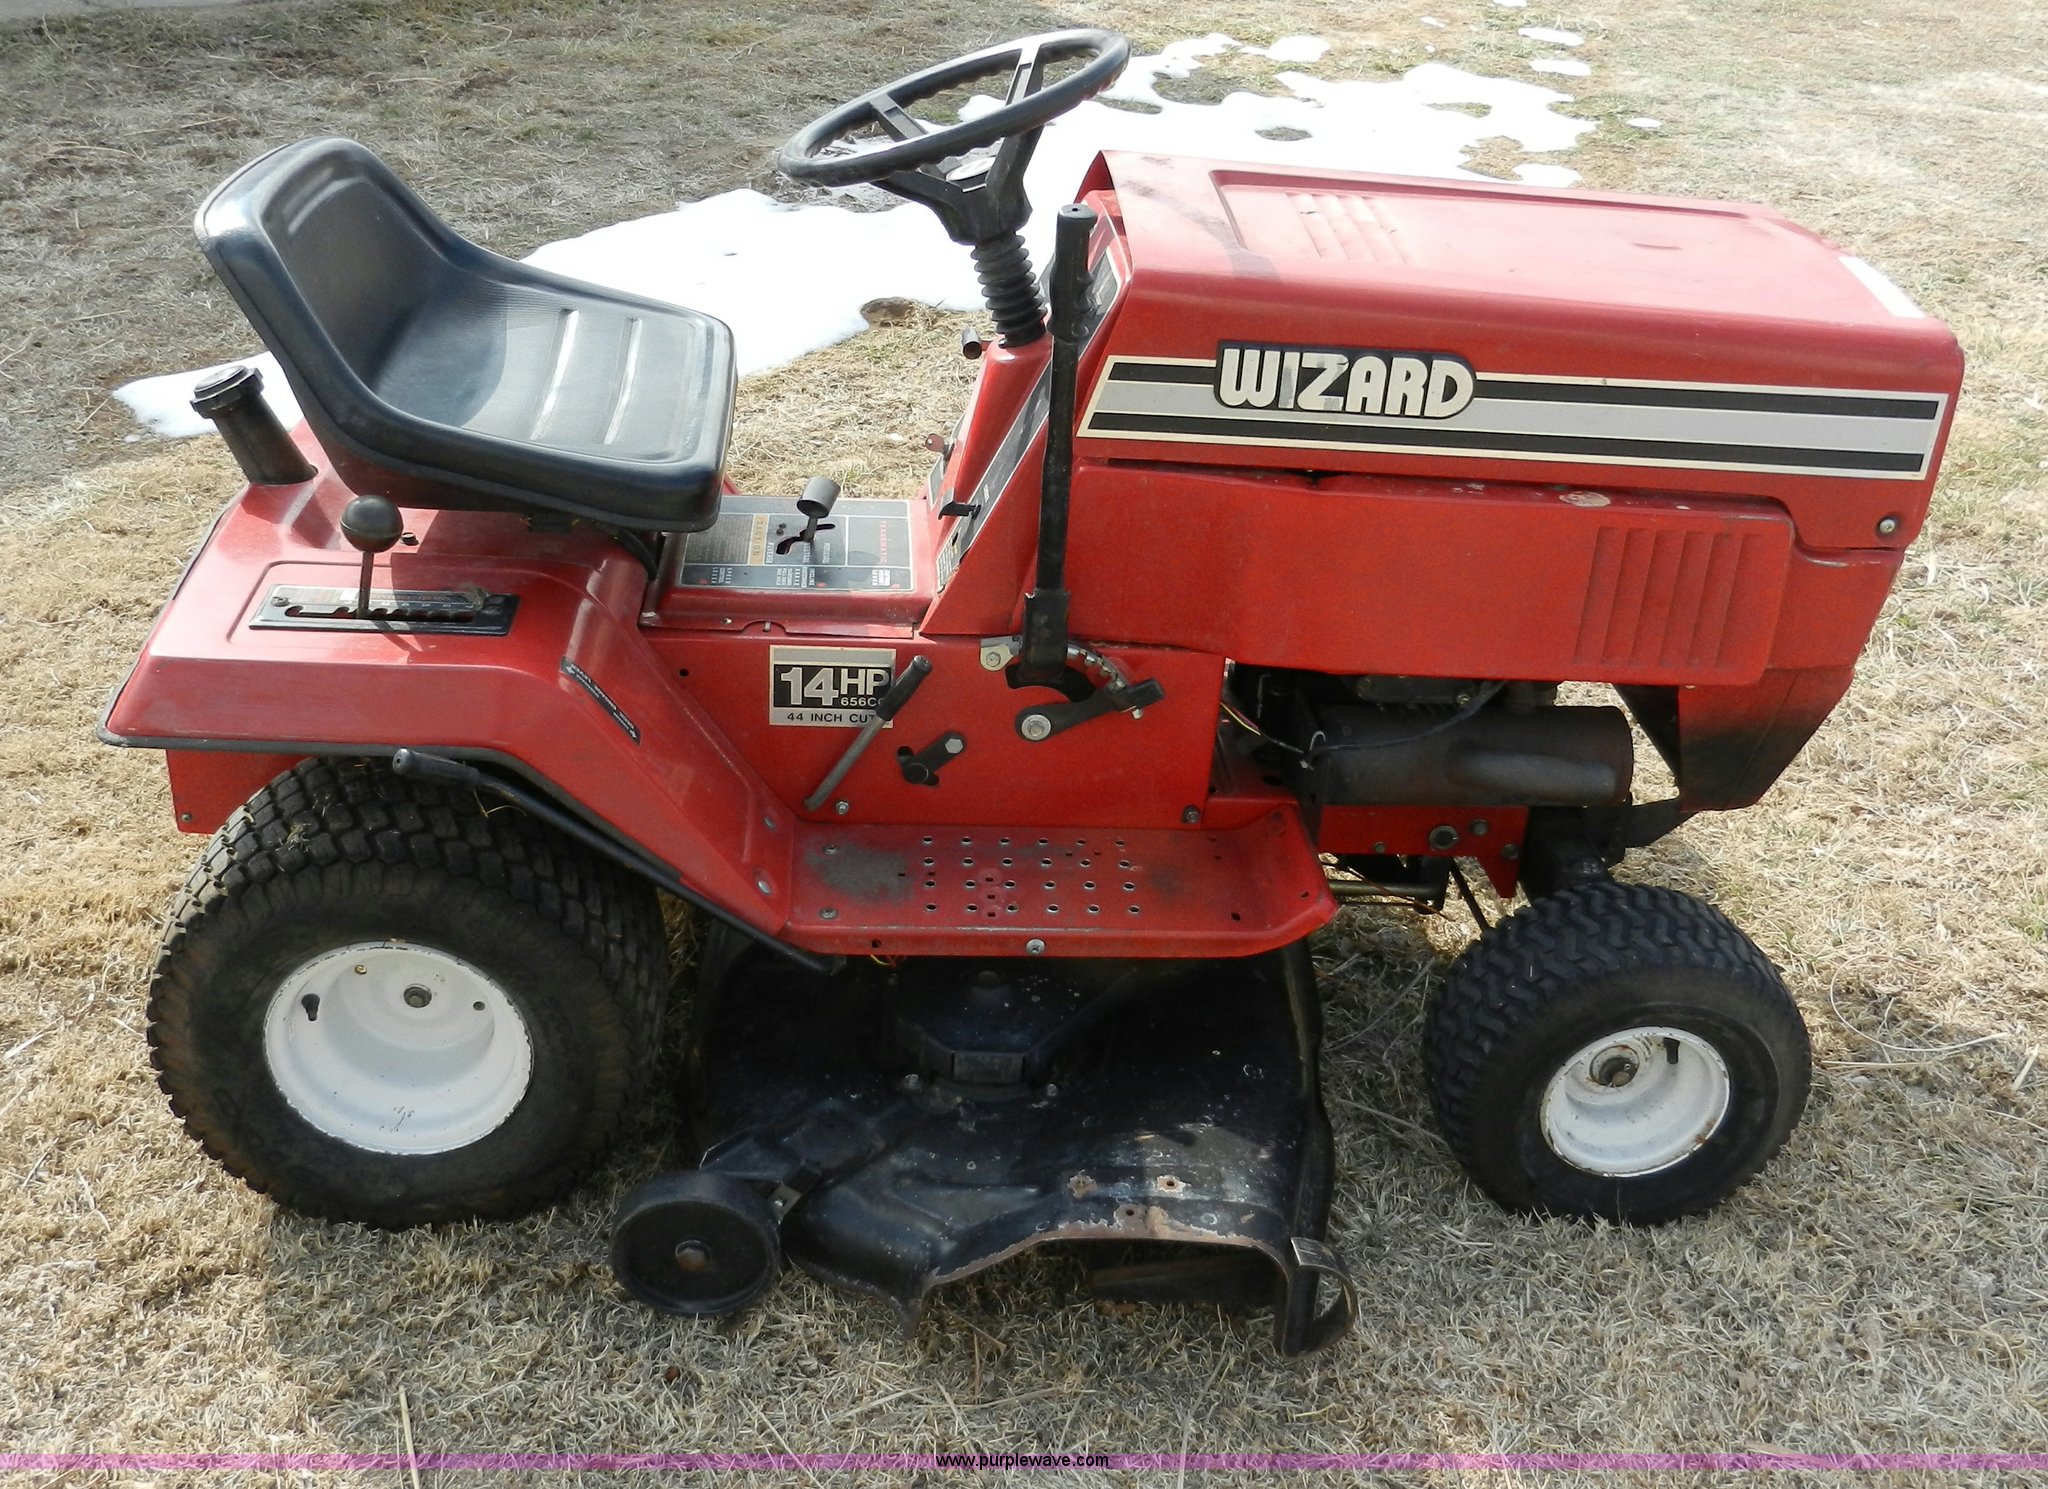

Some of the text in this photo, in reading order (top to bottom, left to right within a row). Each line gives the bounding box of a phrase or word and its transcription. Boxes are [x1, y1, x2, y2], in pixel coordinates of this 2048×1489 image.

[1219, 348, 1474, 418] WIZARD
[787, 712, 875, 723] 44 INCH CUT
